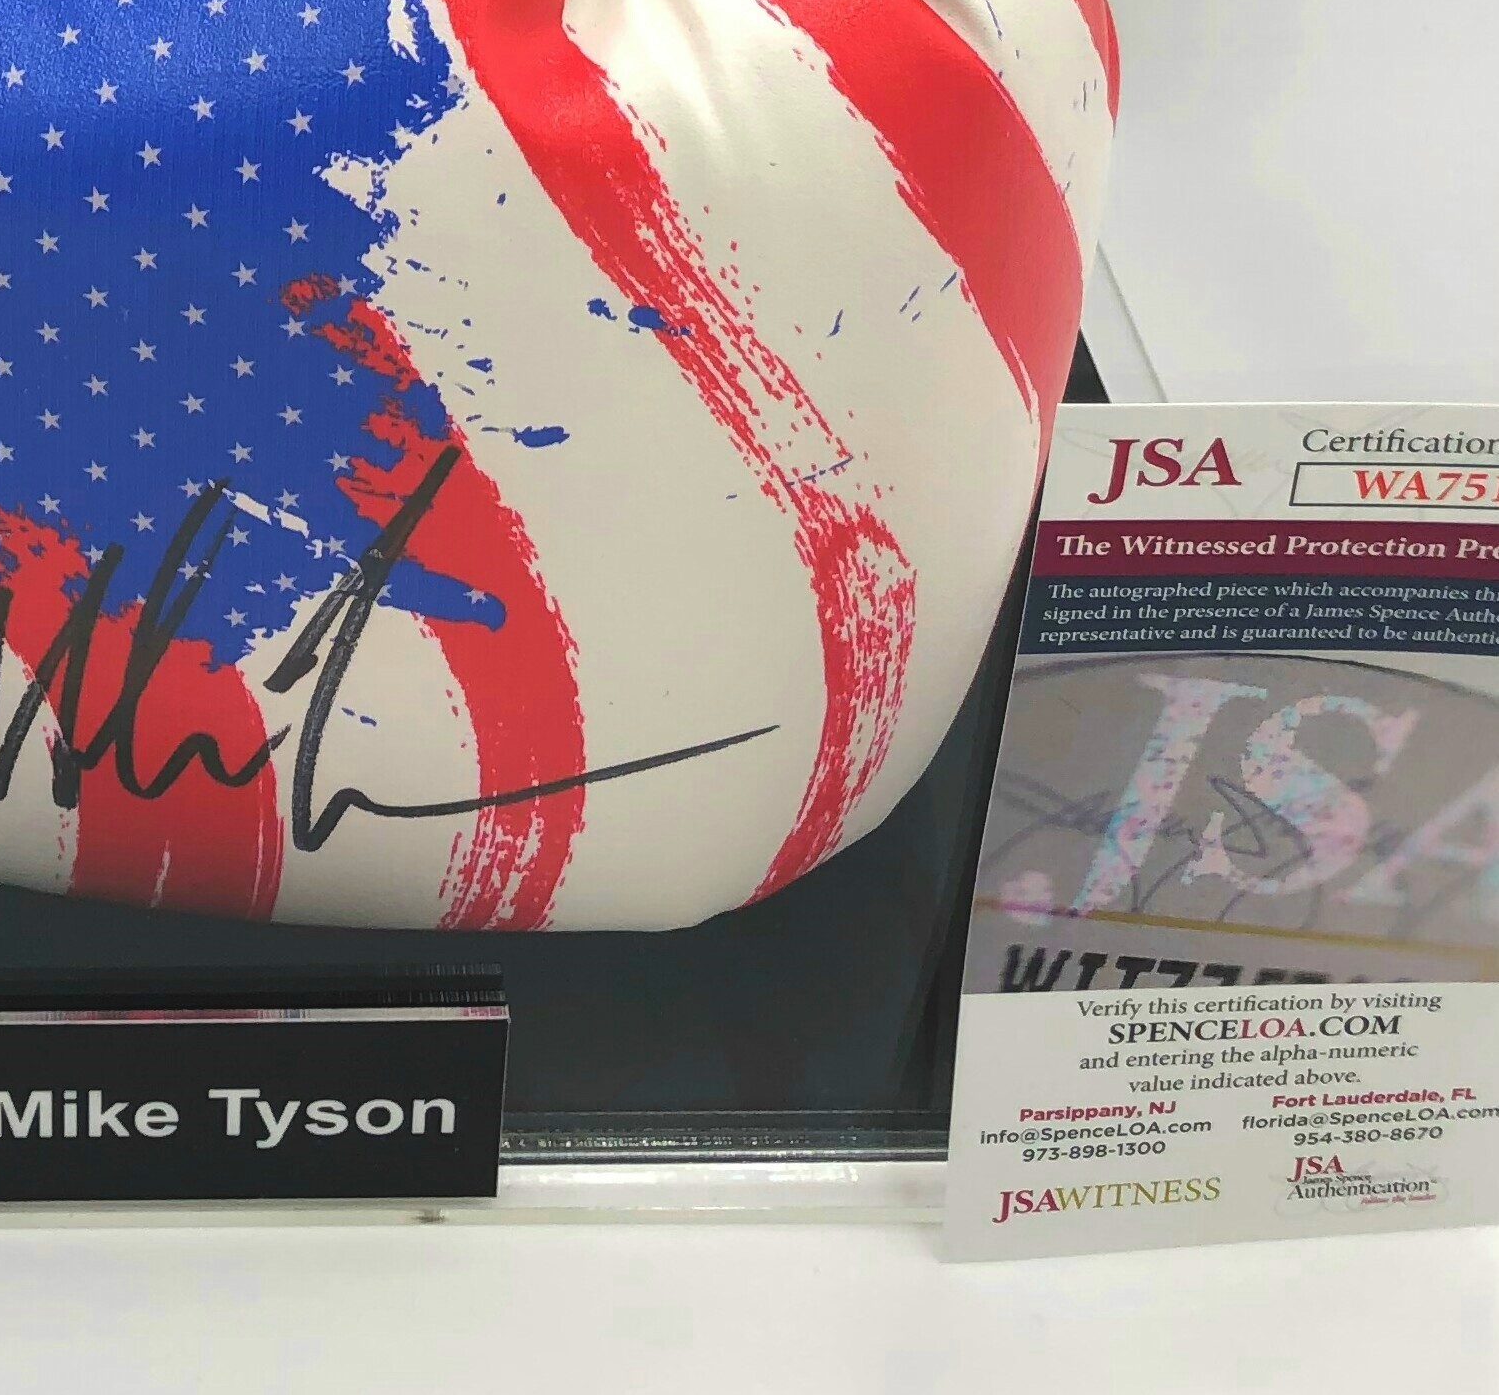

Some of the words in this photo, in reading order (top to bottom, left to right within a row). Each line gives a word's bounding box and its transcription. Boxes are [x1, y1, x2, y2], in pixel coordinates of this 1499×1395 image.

[1087, 437, 1242, 505] JSA
[1057, 535, 1111, 556] The
[1121, 535, 1275, 556] Witnessed
[1284, 536, 1446, 559] Protection
[1048, 583, 1084, 599] The
[1089, 582, 1212, 602] autographed
[1216, 583, 1268, 601] piece
[1274, 581, 1333, 598] which
[1339, 585, 1469, 602] accompanies
[1042, 604, 1107, 624] signed
[1112, 605, 1131, 619] in
[1138, 604, 1169, 620] the
[1173, 606, 1259, 622] presence
[1264, 602, 1288, 618] of
[1288, 607, 1301, 618] a
[1305, 604, 1363, 620] James
[1369, 604, 1440, 622] Spence
[1039, 626, 1175, 645] representative
[1179, 625, 1217, 639] and
[1222, 625, 1237, 640] is
[1241, 624, 1352, 642] guaranteed
[1358, 626, 1378, 639] to
[1383, 625, 1408, 641] be
[1077, 997, 1142, 1020] Verify
[1148, 997, 1188, 1015] this
[1193, 994, 1323, 1015] certification
[1330, 993, 1356, 1013] by
[1363, 993, 1442, 1012] visiting
[1108, 1014, 1402, 1044] SPENCELOA.COM
[1079, 1052, 1119, 1070] and
[1125, 1048, 1214, 1069] entering
[1220, 1045, 1255, 1064] the
[1260, 1042, 1419, 1066] alpha-numeric
[1129, 1075, 1184, 1093] value
[1189, 1070, 1287, 1090] indicated
[1294, 1068, 1361, 1086] above.
[1272, 1094, 1317, 1108] Fort
[1322, 1089, 1445, 1106] Lauderdale,
[1451, 1088, 1476, 1100] FL
[208, 1088, 456, 1150] Tyson
[1019, 1105, 1142, 1122] Parsippany,
[1149, 1101, 1176, 1114] NJ
[1242, 1107, 1499, 1130] florida@SpenceLOA.com
[980, 1121, 1212, 1144] info@SpenceLOA.com
[1293, 1126, 1443, 1146] 954-380-8670
[1022, 1140, 1166, 1162] 973-898-1300
[1287, 1154, 1344, 1182] JSA
